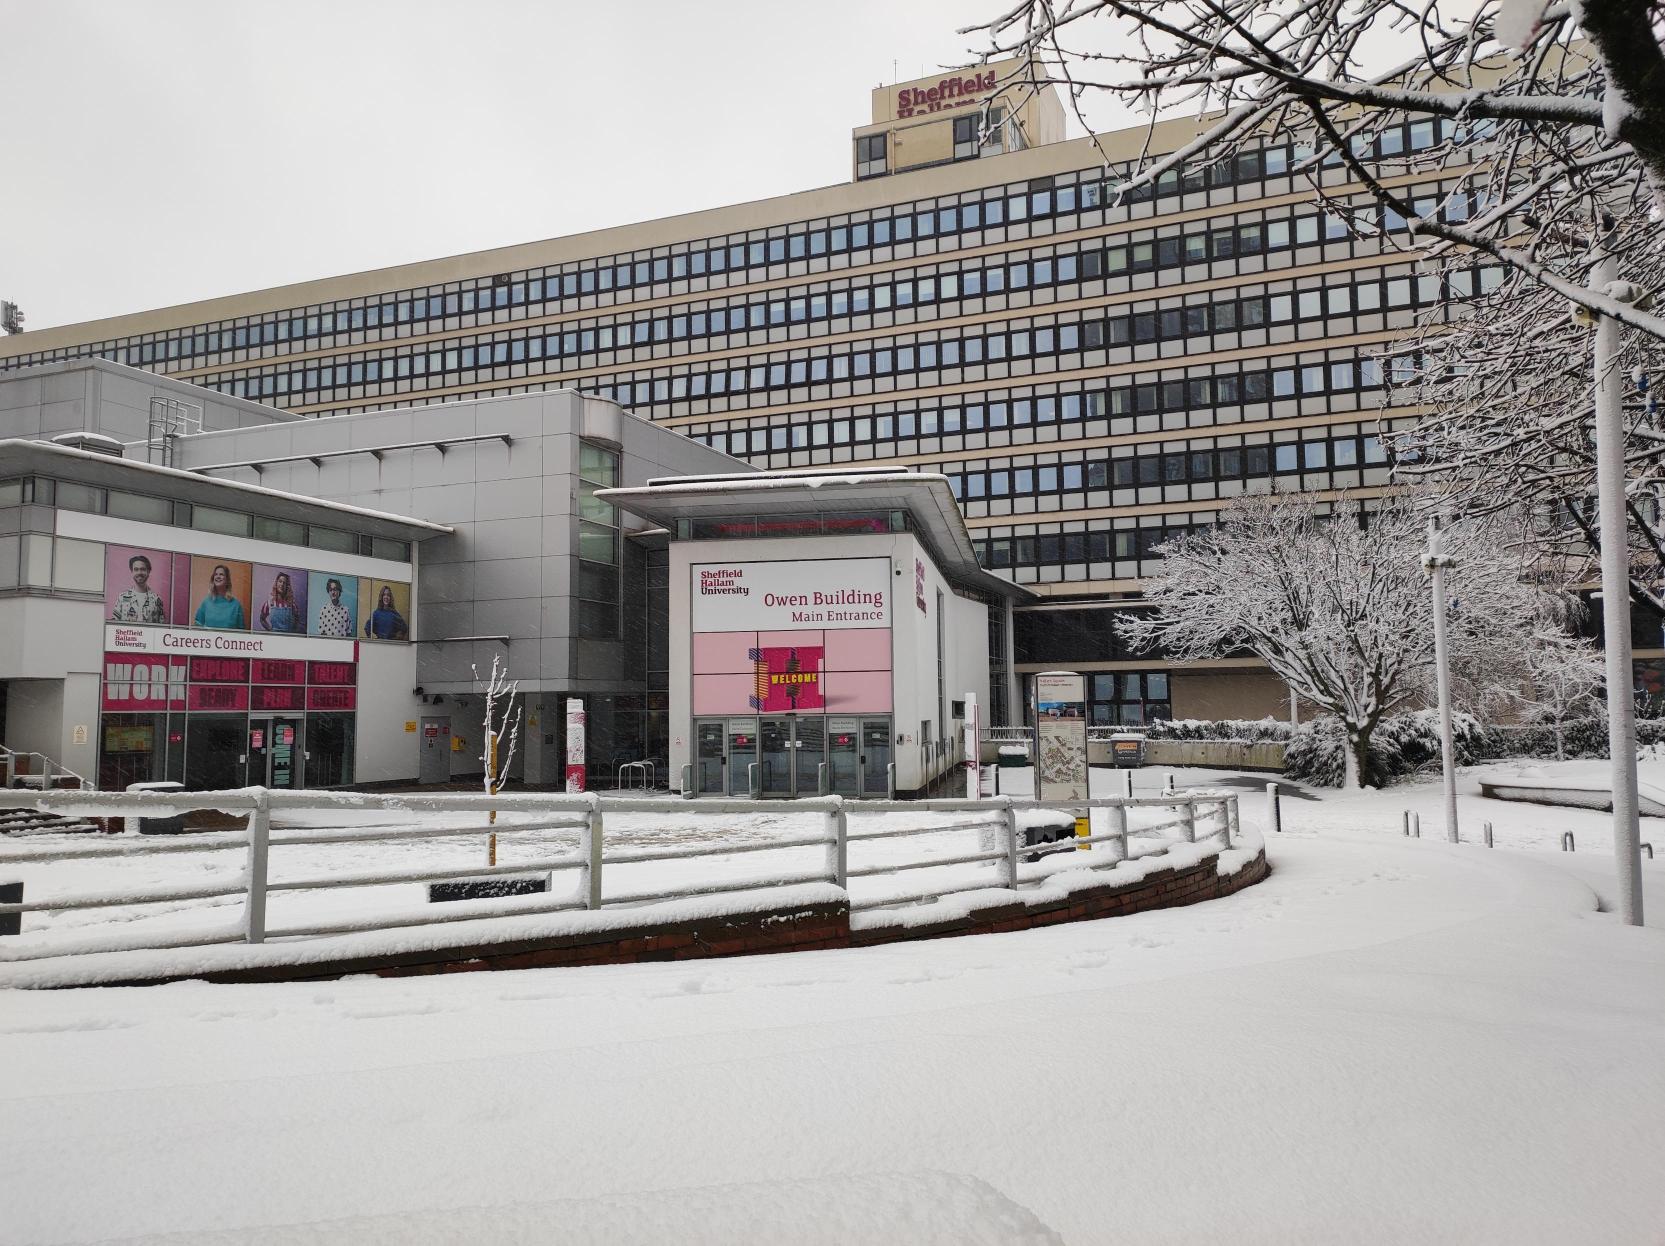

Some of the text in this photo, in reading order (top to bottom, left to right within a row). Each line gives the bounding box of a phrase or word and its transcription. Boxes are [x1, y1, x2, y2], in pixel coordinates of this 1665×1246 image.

[898, 70, 997, 109] Sheffield
[897, 98, 976, 119] Hll
[700, 569, 743, 579] Sheffield
[700, 578, 735, 587] Hallam
[700, 586, 750, 597] University
[764, 589, 883, 607] Owen Building
[791, 610, 883, 622] Main Entrance
[115, 629, 143, 637] Sheffield
[115, 641, 147, 650] University
[162, 633, 264, 652] Careers Connect
[106, 663, 187, 700] WORK
[771, 673, 817, 684] WELCOME
